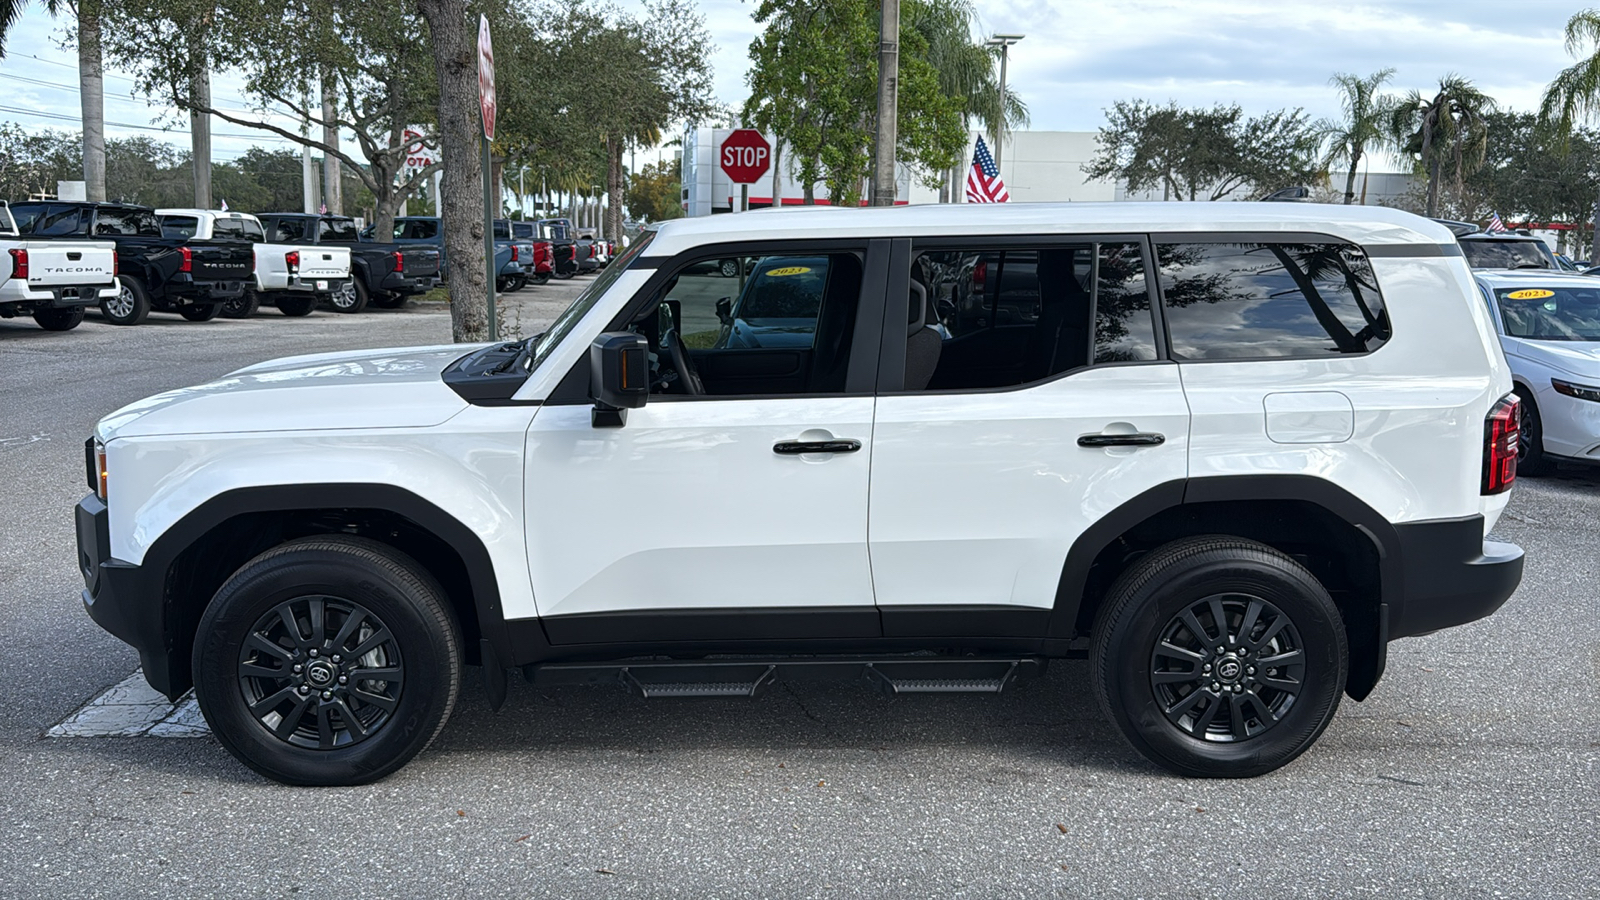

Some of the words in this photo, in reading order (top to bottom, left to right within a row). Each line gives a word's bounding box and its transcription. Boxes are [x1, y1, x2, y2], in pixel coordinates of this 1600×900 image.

[723, 146, 767, 167] STOP
[407, 157, 431, 167] OTA
[1517, 290, 1547, 298] 2023
